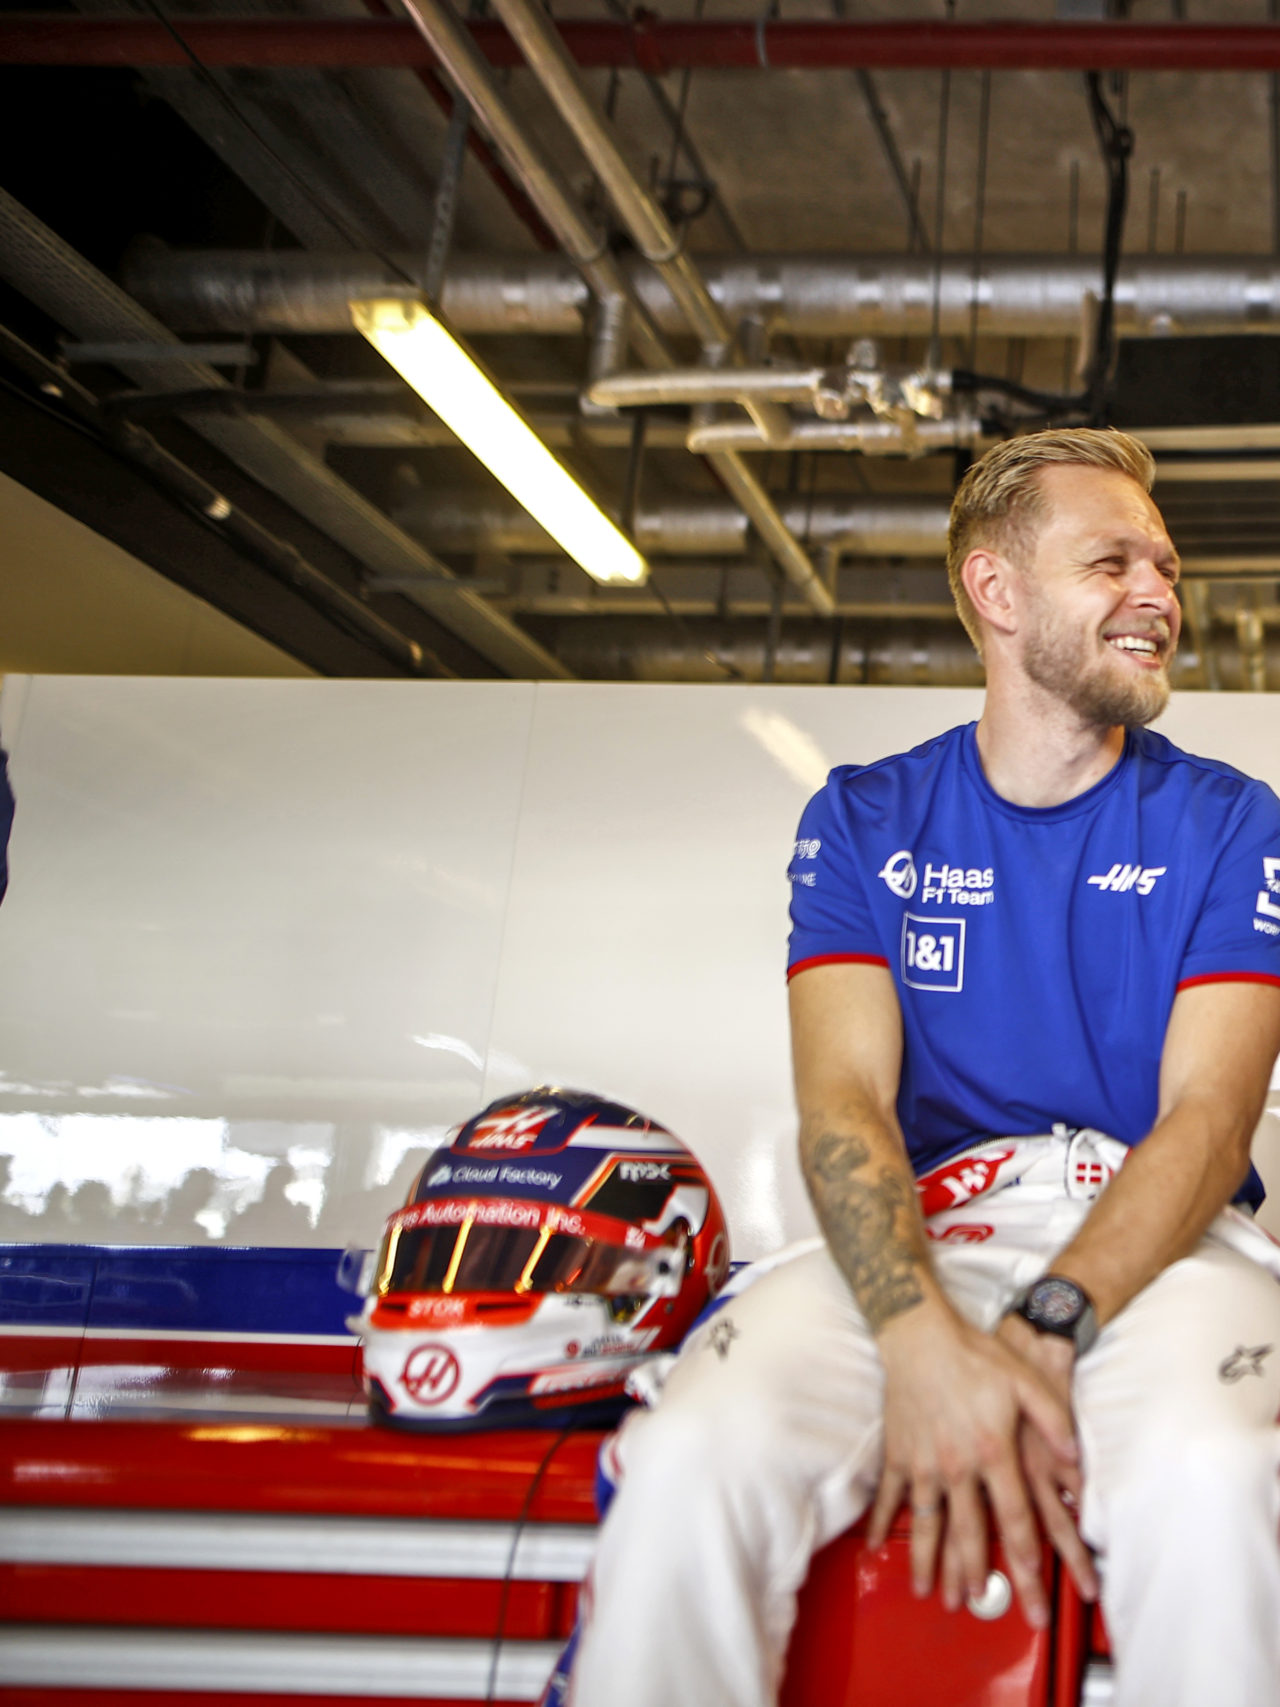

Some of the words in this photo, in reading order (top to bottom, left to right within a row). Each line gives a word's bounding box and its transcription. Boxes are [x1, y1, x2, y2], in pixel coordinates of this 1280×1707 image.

[923, 862, 994, 889] Haas
[947, 888, 994, 905] Team
[906, 931, 955, 971] 1&1
[452, 1166, 500, 1183] Cloud
[499, 1166, 562, 1190] Factory
[545, 1207, 586, 1235] Inc.
